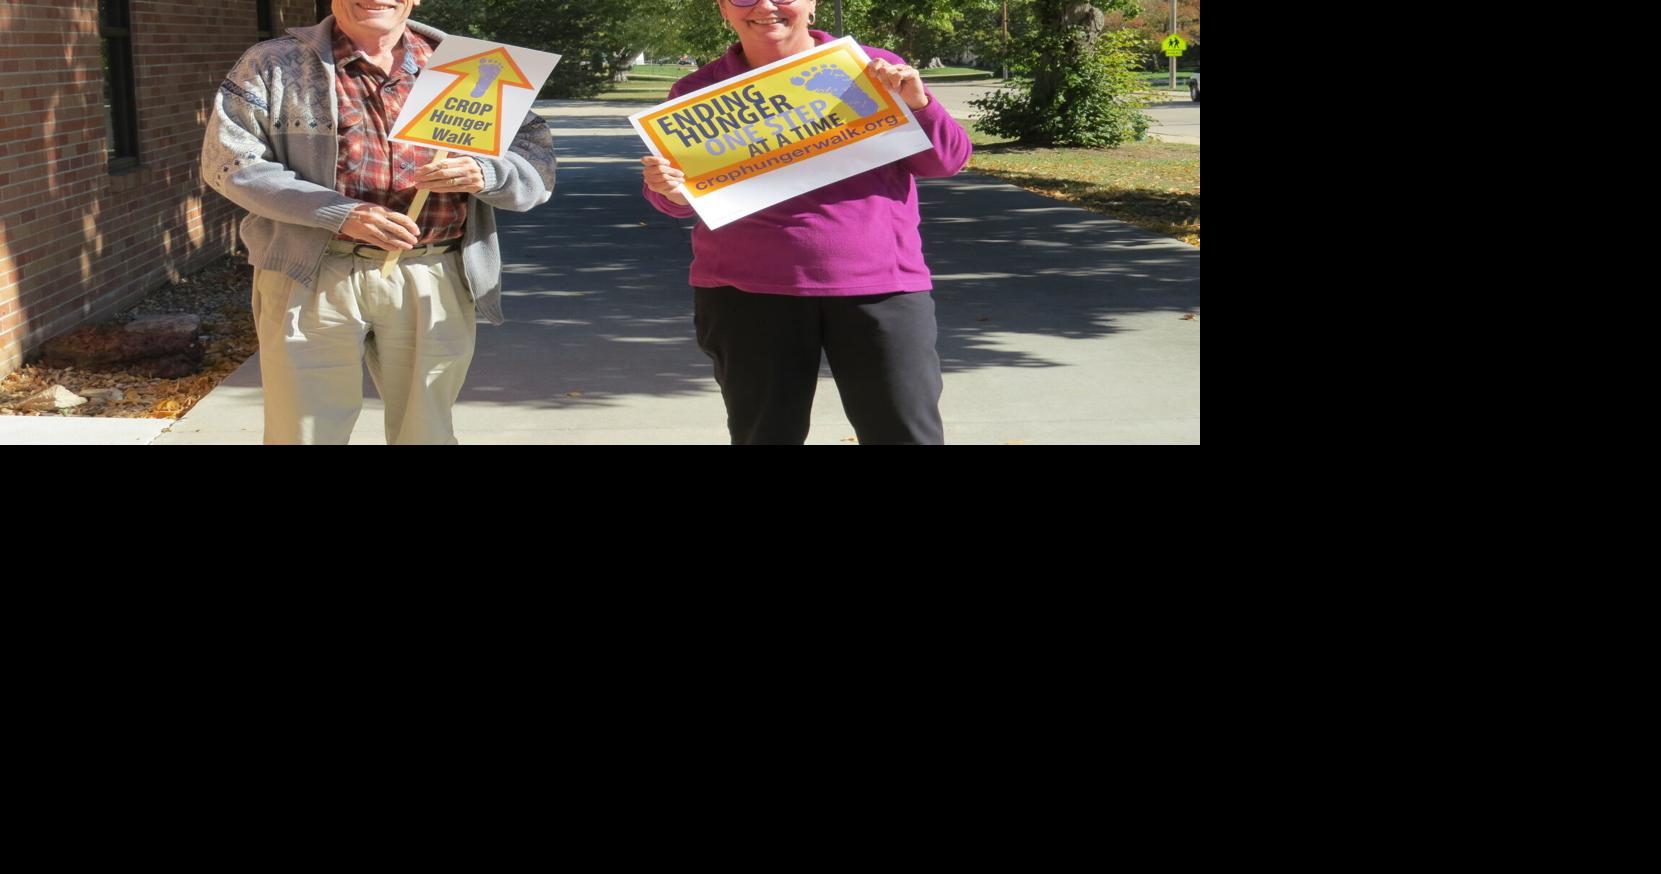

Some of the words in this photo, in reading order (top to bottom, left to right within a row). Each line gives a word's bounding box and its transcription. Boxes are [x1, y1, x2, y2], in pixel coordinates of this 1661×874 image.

[430, 109, 493, 131] Hunger
[444, 97, 493, 116] CROP
[657, 84, 765, 135] ENDING
[674, 94, 794, 147] HUNGER
[704, 124, 761, 156] ONE
[764, 99, 828, 136] STEP
[432, 127, 475, 145] Walk
[695, 113, 898, 191] crophungerwalk.org
[748, 138, 771, 157] AT
[776, 133, 792, 148] A
[790, 113, 844, 141] TIME
